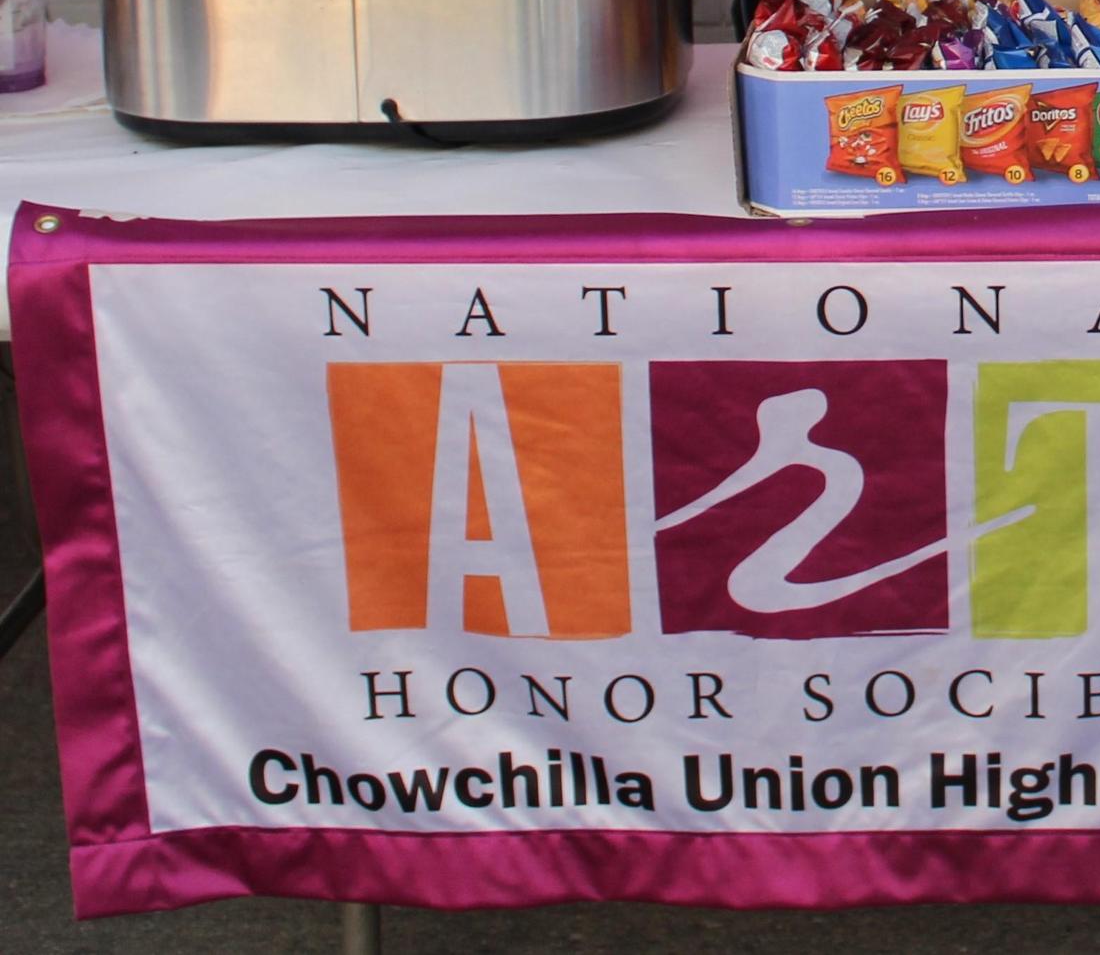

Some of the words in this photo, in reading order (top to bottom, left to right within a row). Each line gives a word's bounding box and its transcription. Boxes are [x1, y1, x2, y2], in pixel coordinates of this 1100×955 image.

[838, 97, 883, 128] Cheetos
[903, 101, 941, 123] Lay's
[964, 103, 1014, 136] Fritos
[879, 172, 893, 182] 16
[942, 171, 956, 182] 12
[1008, 170, 1021, 180] 10
[1075, 169, 1083, 179] 8
[360, 667, 733, 723] HONOR
[249, 749, 656, 813] Chowchilla
[684, 754, 900, 812] Union
[931, 752, 1097, 822] High
